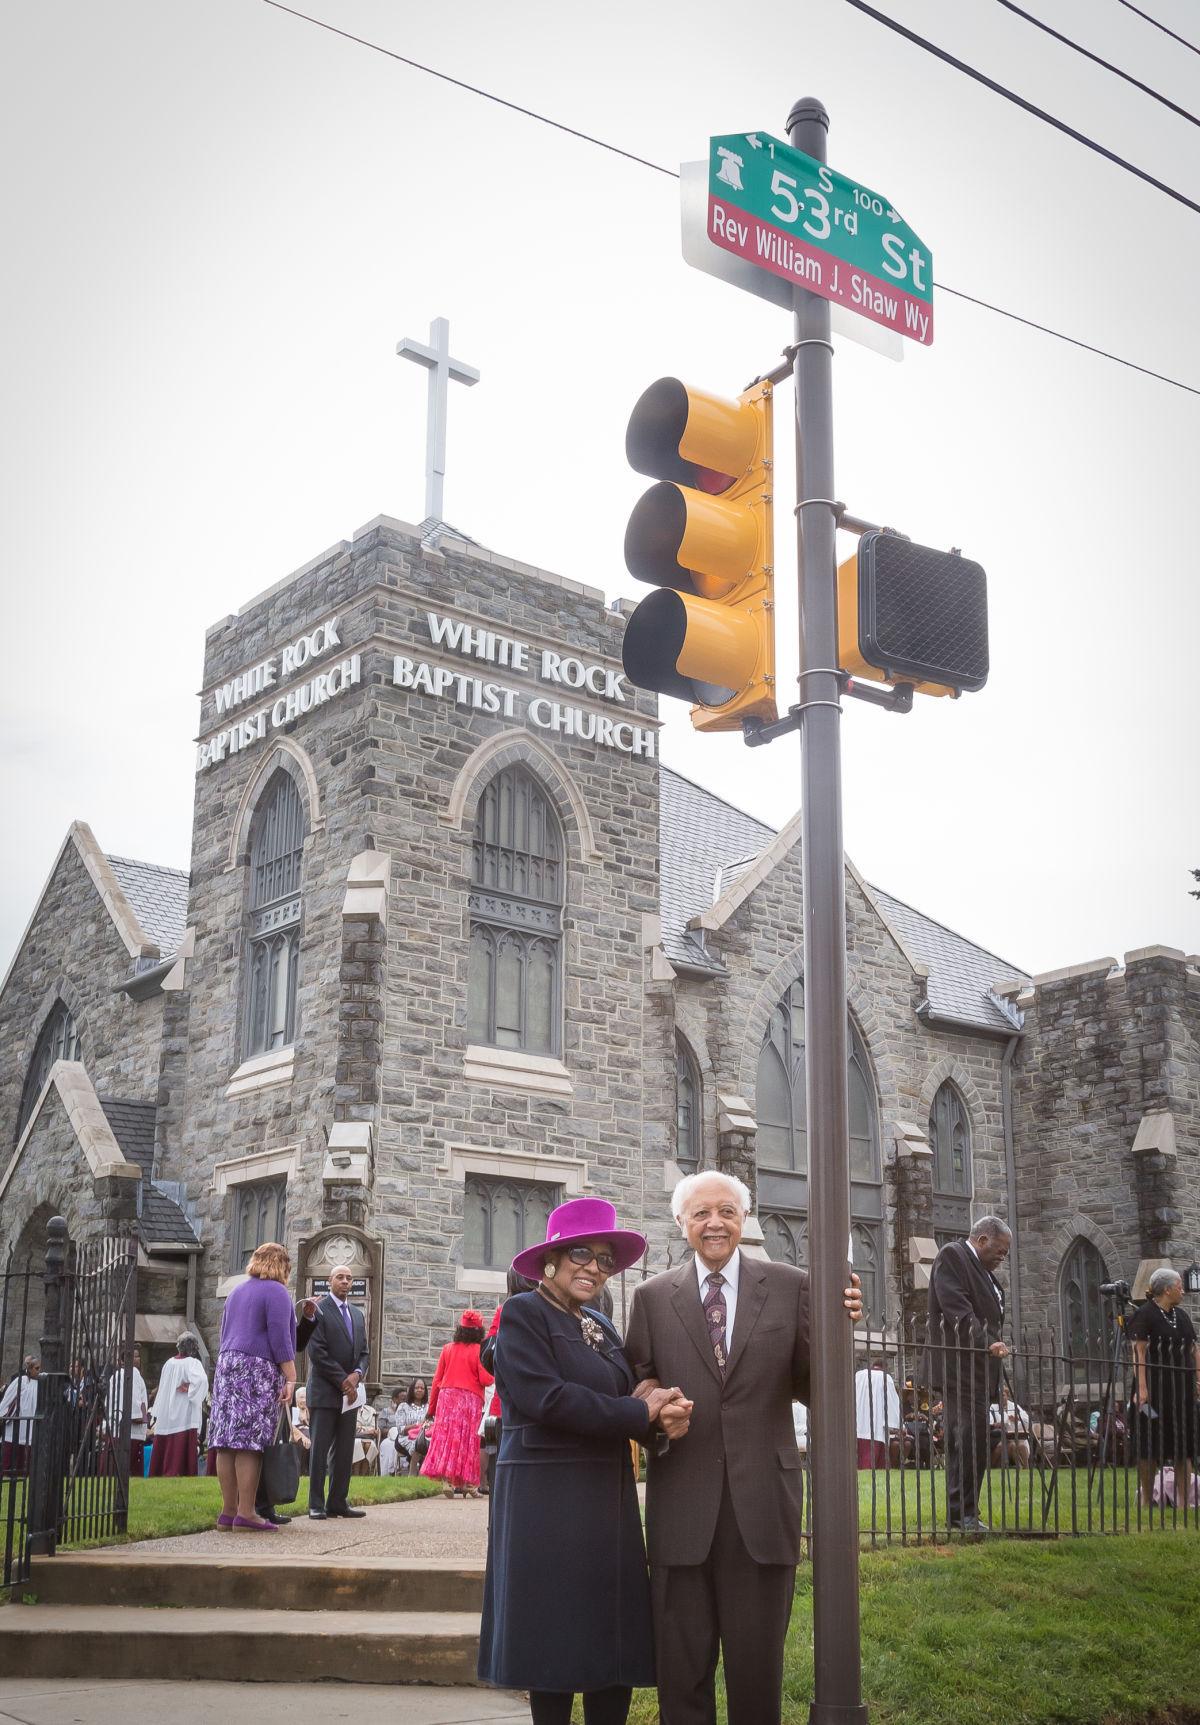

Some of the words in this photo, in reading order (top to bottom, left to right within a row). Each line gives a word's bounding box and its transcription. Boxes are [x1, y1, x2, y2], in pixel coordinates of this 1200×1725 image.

[768, 143, 775, 160] 1
[818, 166, 834, 193] S
[852, 189, 883, 216] 100
[713, 204, 748, 247] Rev
[756, 225, 822, 285] William
[829, 265, 843, 295] J.
[851, 274, 898, 321] Shaw
[904, 300, 929, 341] Wy
[881, 233, 926, 292] St
[215, 656, 277, 714] WHITE
[282, 616, 341, 677] ROCK
[427, 612, 529, 672] WHITE
[541, 650, 626, 702] ROCK
[196, 708, 270, 773] BAPTIST
[271, 654, 361, 728] CHURCH
[393, 655, 520, 718] BAPTIST
[528, 698, 655, 758] CHURCH
